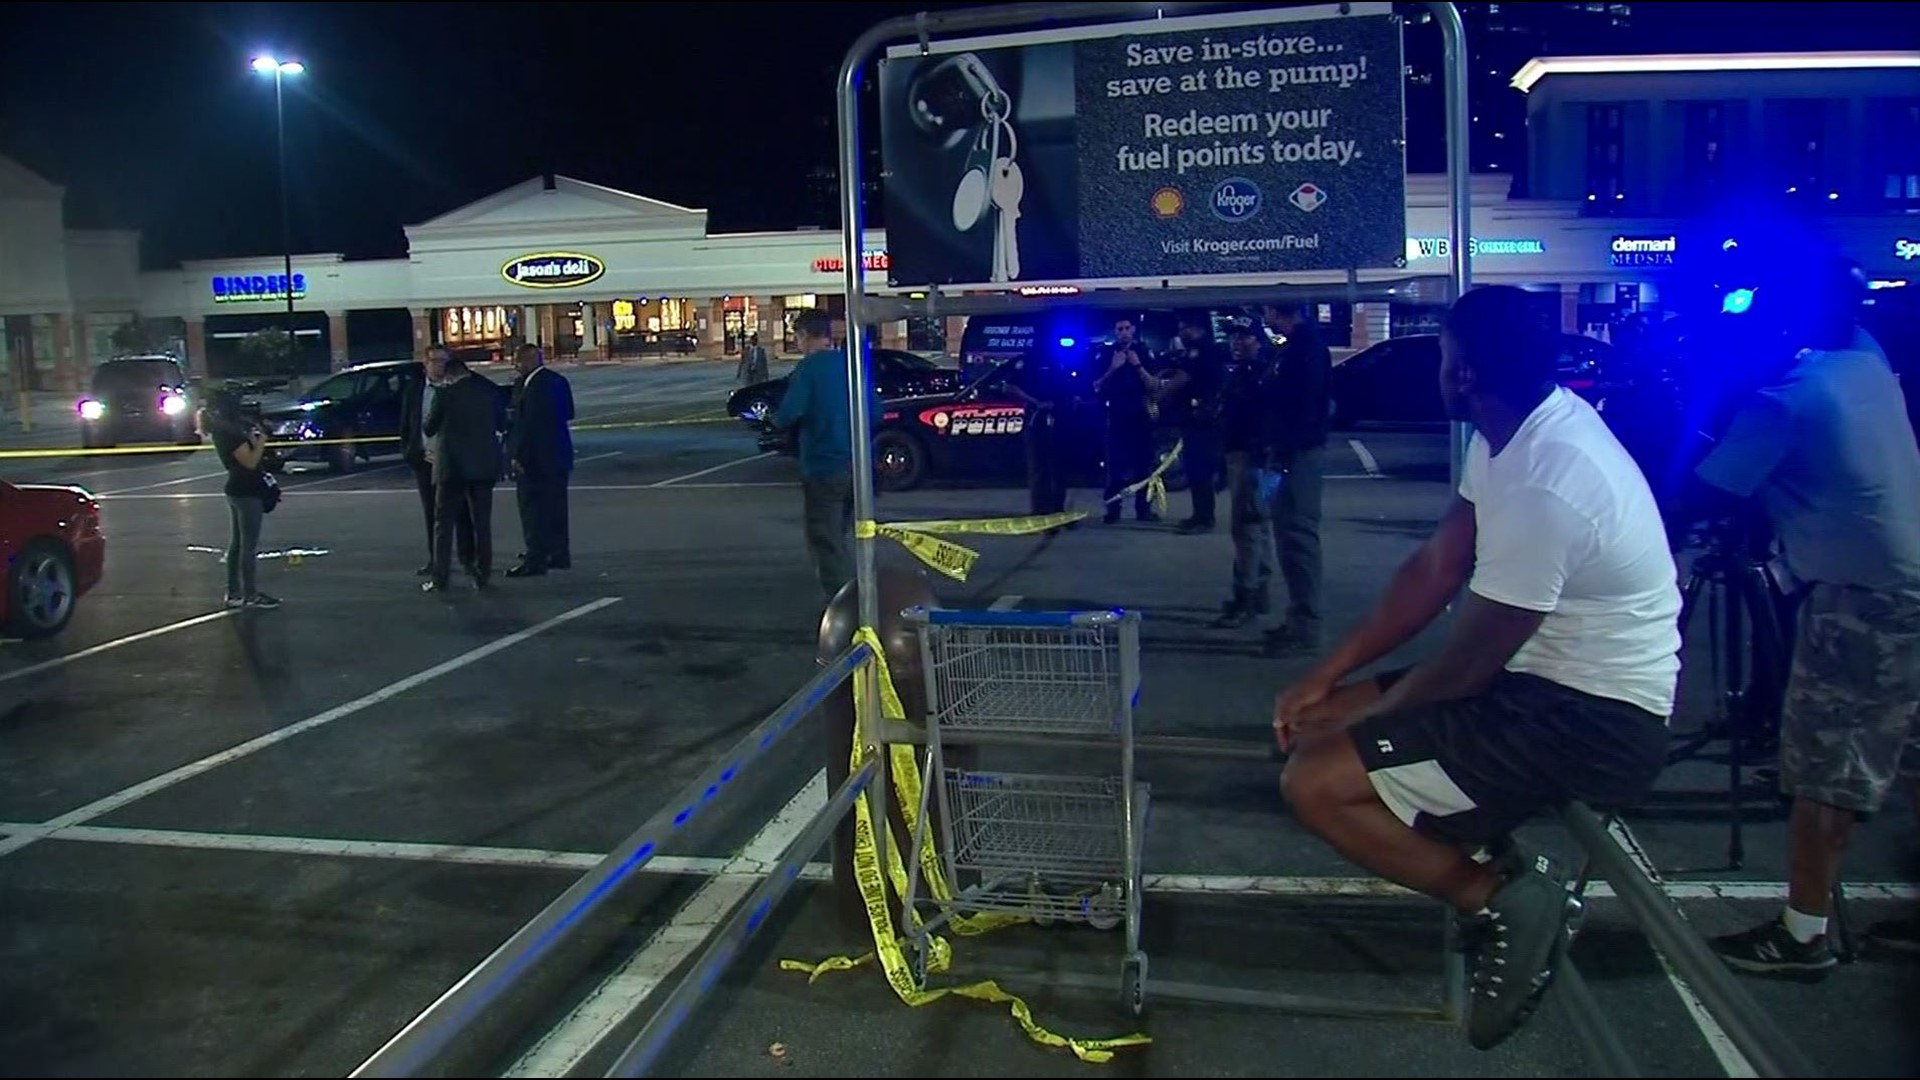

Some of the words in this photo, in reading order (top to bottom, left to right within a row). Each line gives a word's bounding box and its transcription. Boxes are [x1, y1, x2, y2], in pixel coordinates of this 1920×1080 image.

[1126, 43, 1193, 67] Save
[1202, 35, 1343, 61] in-store...
[1106, 76, 1172, 97] save
[1180, 69, 1207, 92] at
[1214, 66, 1261, 89] the
[1268, 56, 1367, 92] pump!
[1144, 110, 1258, 137] Redeem
[1265, 108, 1332, 137] your
[1117, 144, 1169, 170] fuel
[1177, 141, 1265, 174] points
[1271, 134, 1362, 167] today.
[1217, 185, 1256, 215] Kroger
[1161, 240, 1190, 253] Visit
[1193, 234, 1319, 254] Kroger.com/Fuel
[1612, 236, 1676, 252] dermani
[562, 260, 590, 275] deli
[1610, 253, 1673, 265] MEDSPA
[213, 274, 306, 295] BINDERS
[951, 418, 1024, 435] POLIC
[857, 853, 875, 870] NOT
